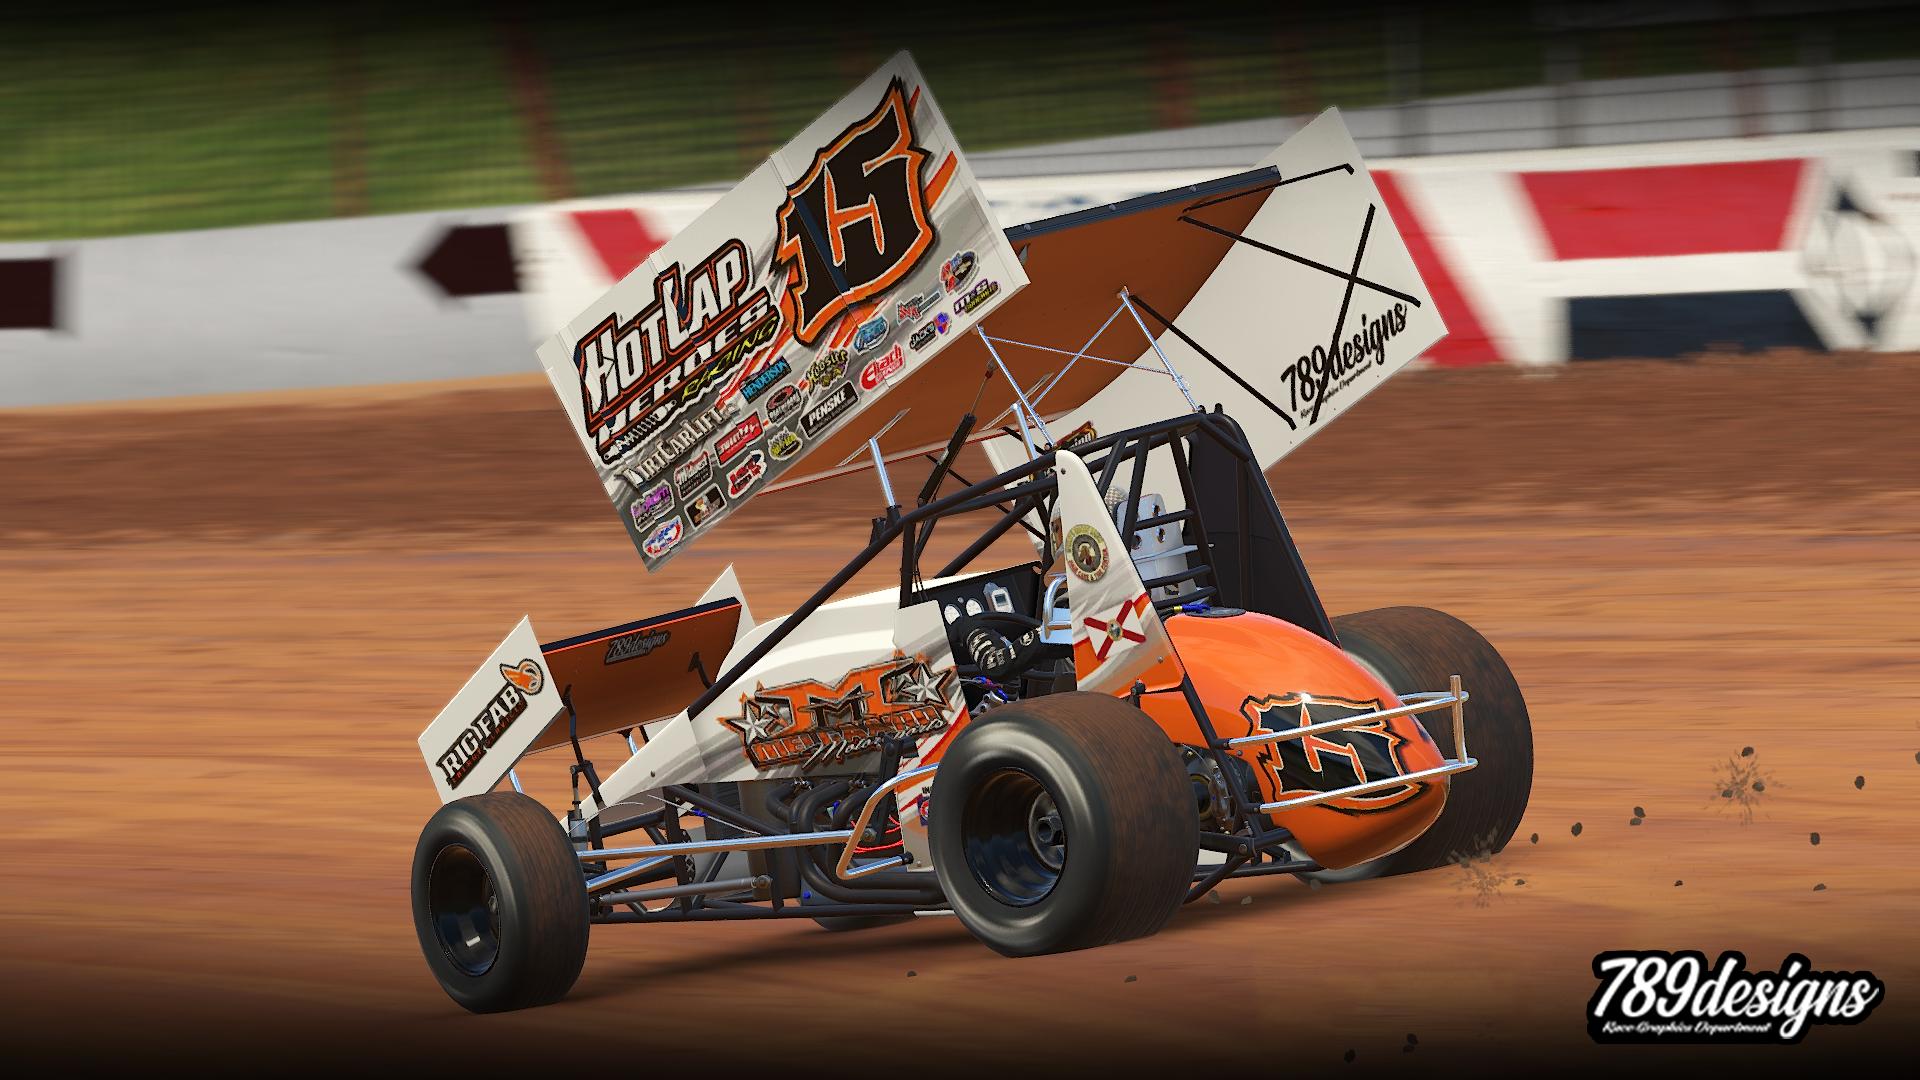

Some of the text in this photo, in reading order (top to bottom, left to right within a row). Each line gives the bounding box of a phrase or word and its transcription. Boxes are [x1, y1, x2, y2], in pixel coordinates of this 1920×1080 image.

[776, 80, 930, 342] 15
[597, 293, 770, 446] HEROES
[681, 316, 778, 401] RACING
[808, 389, 848, 427] PENSKE
[1280, 302, 1408, 412] 789designs
[442, 685, 521, 779] RIG FAB
